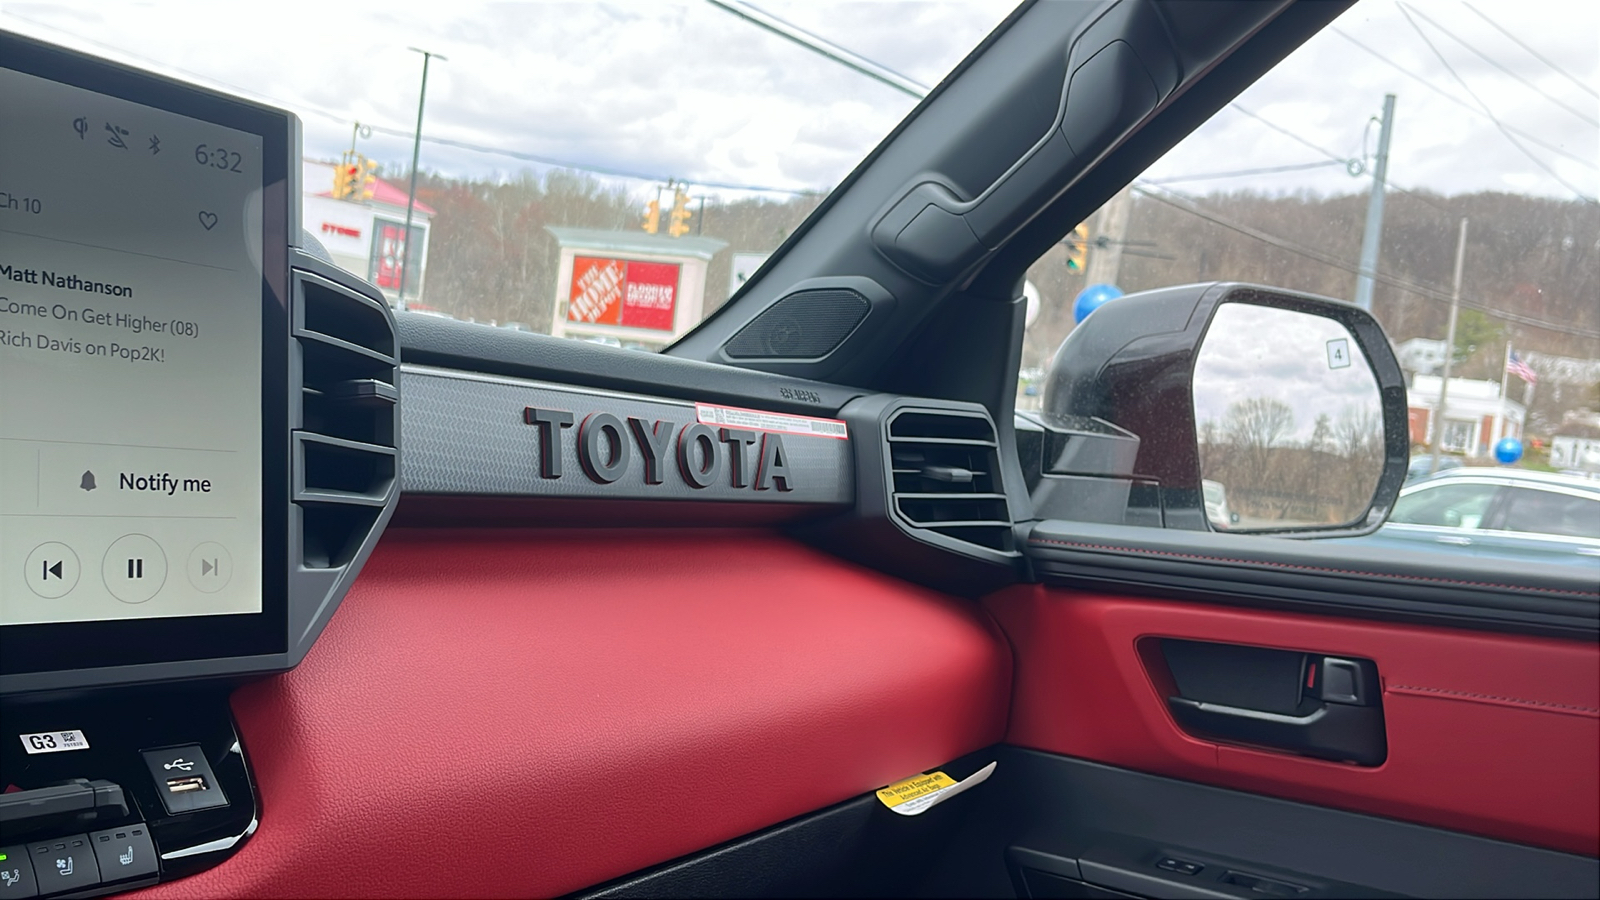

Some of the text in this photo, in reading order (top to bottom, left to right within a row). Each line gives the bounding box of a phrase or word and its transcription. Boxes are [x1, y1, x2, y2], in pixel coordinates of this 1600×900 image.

[195, 144, 242, 173] 6:32
[0, 192, 41, 214] Ch 10
[0, 264, 133, 298] Matt Nathanson
[0, 297, 199, 339] Come On Get Higher (08)
[0, 330, 165, 363] Rich Davis on Pop2K!
[525, 406, 793, 492] TOYOTA
[119, 472, 212, 495] Notify me
[29, 734, 57, 750] G3
